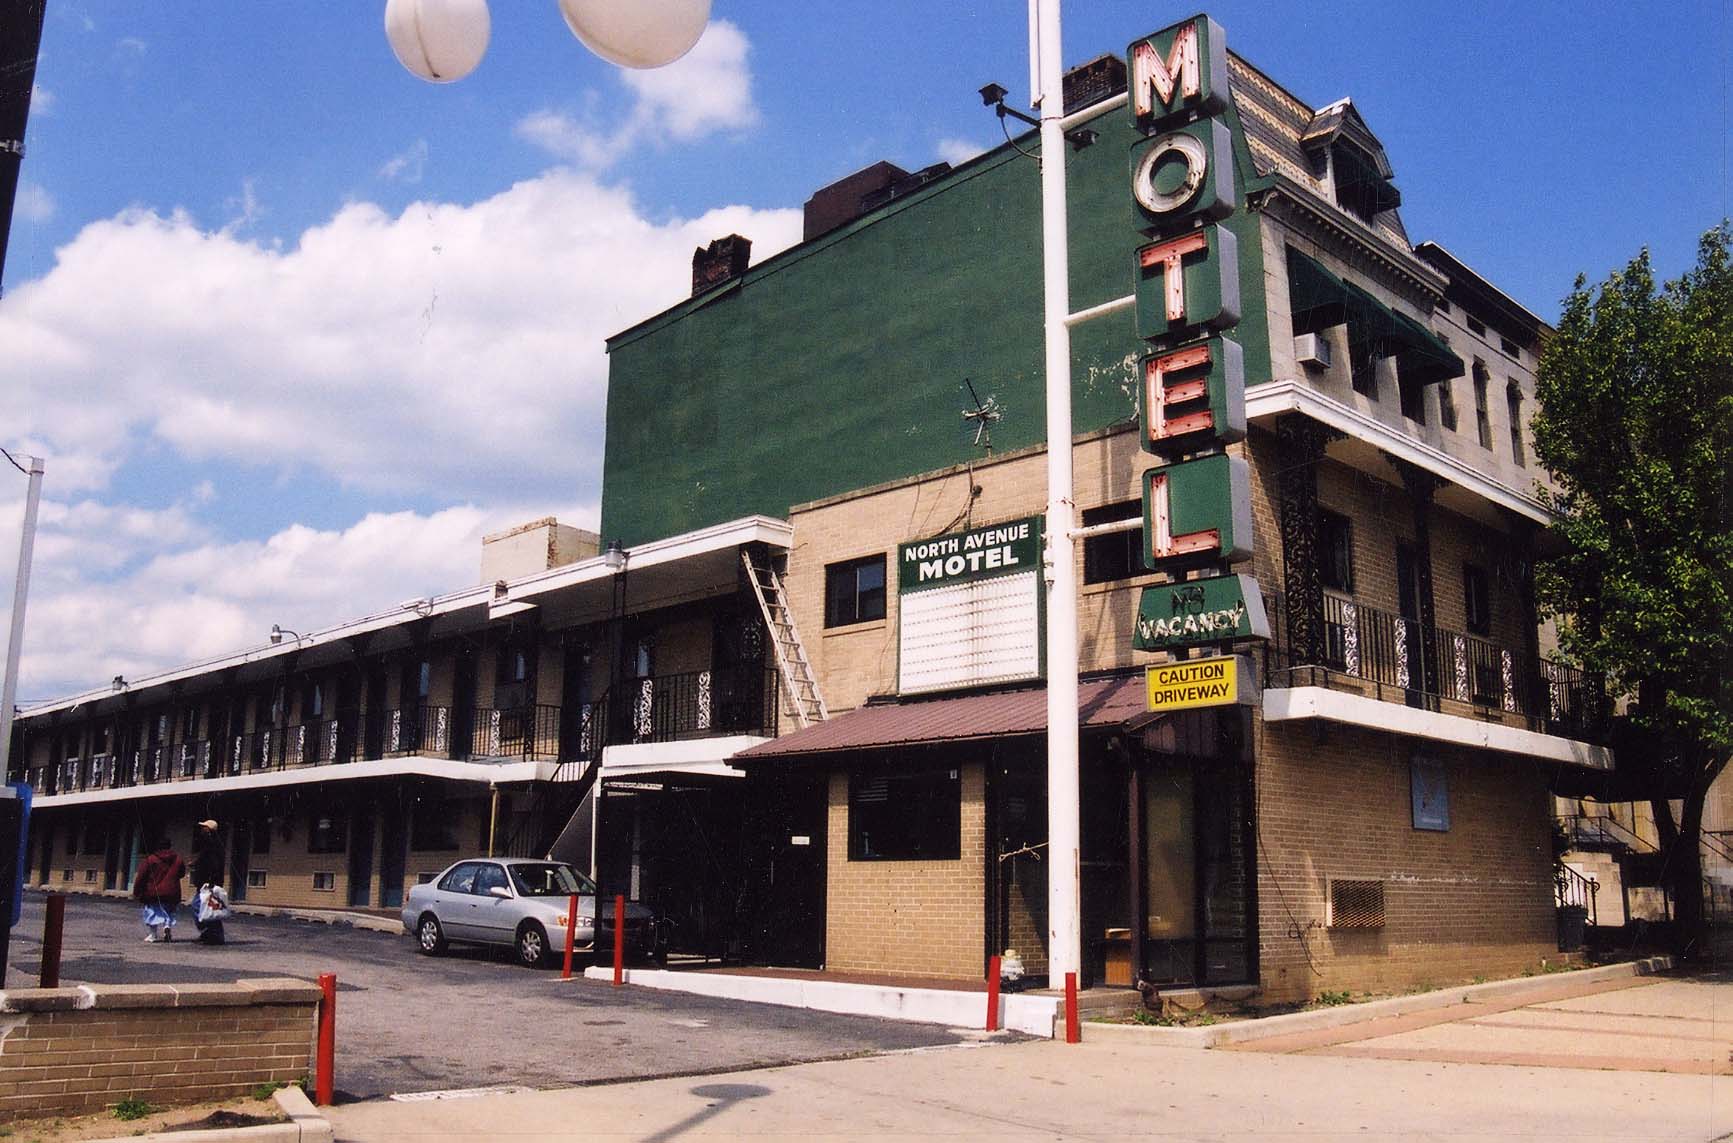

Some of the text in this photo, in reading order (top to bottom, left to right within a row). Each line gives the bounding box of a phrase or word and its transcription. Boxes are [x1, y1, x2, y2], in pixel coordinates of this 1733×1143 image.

[1133, 21, 1220, 558] MOTEL
[906, 524, 1029, 561] NORTH AVENUE
[919, 545, 1019, 581] MOTEL
[1138, 604, 1244, 640] VACANCY
[1154, 683, 1230, 704] DRIVEWAY
[1159, 664, 1224, 687] CAUTION
